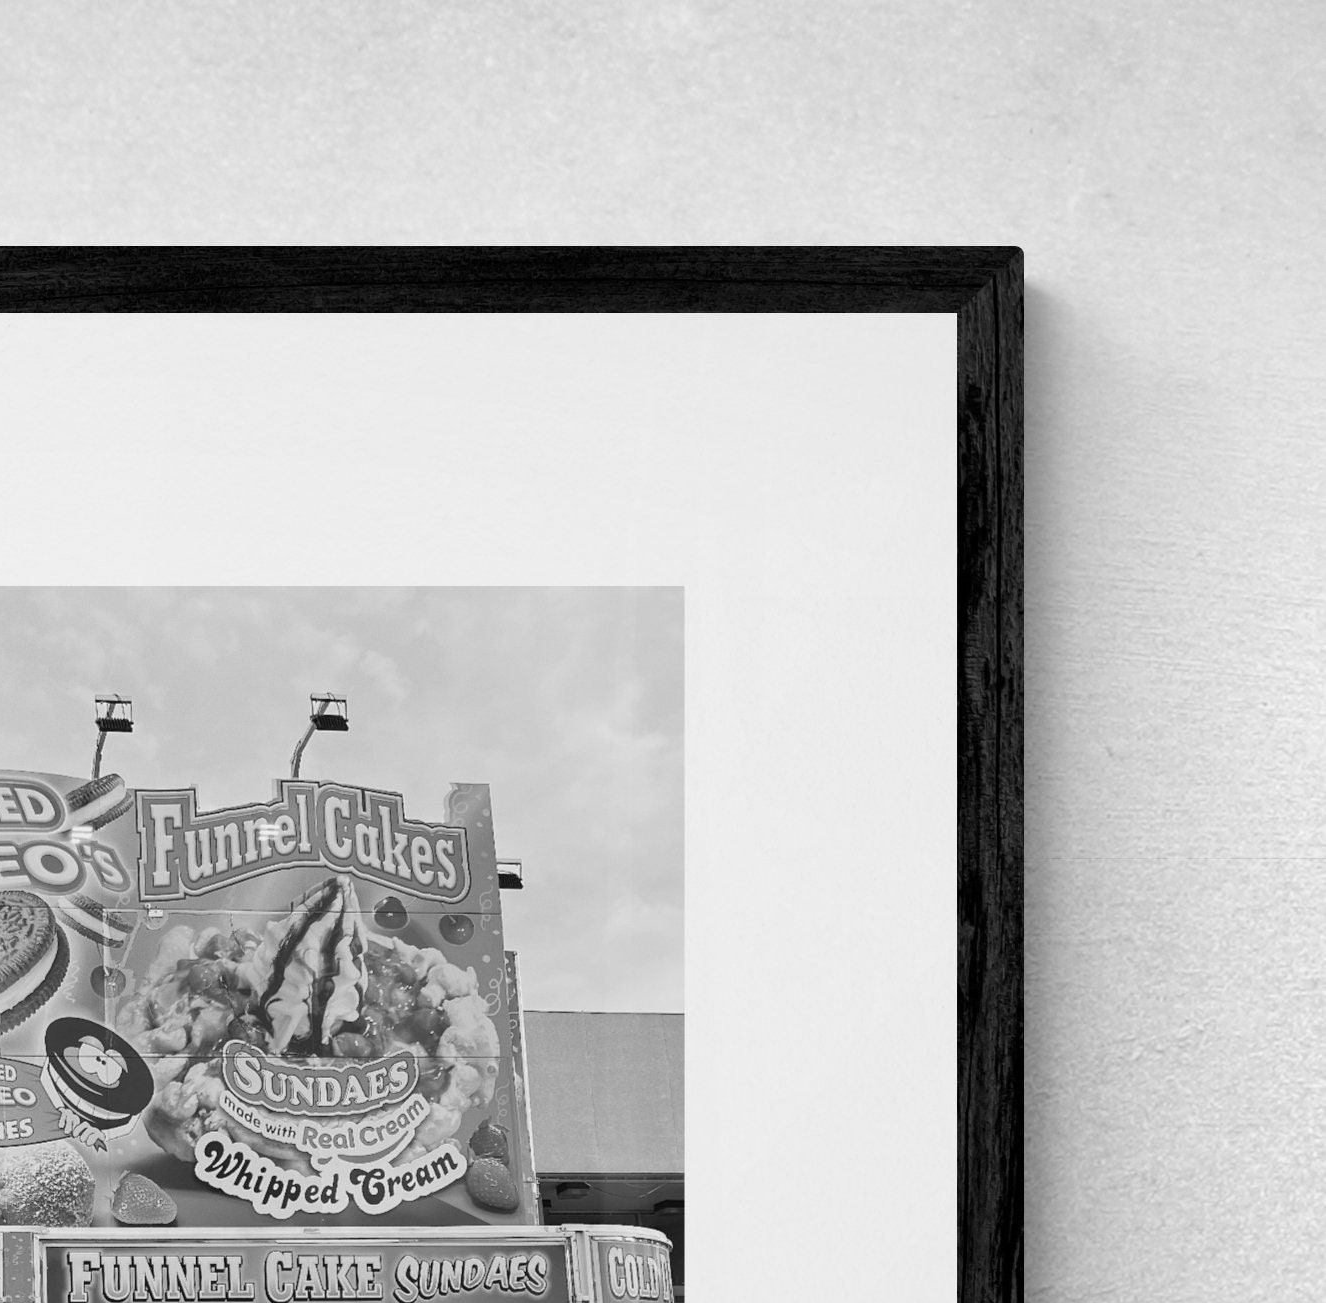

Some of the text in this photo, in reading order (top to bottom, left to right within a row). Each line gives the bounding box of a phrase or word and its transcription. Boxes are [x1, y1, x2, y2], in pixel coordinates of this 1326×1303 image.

[149, 794, 455, 890] Funnel Cakes
[232, 1051, 410, 1107] SUNDAES
[224, 1096, 426, 1150] made with Real Cream
[203, 1139, 459, 1210] Whipped Cream
[608, 1246, 660, 1301] COLD
